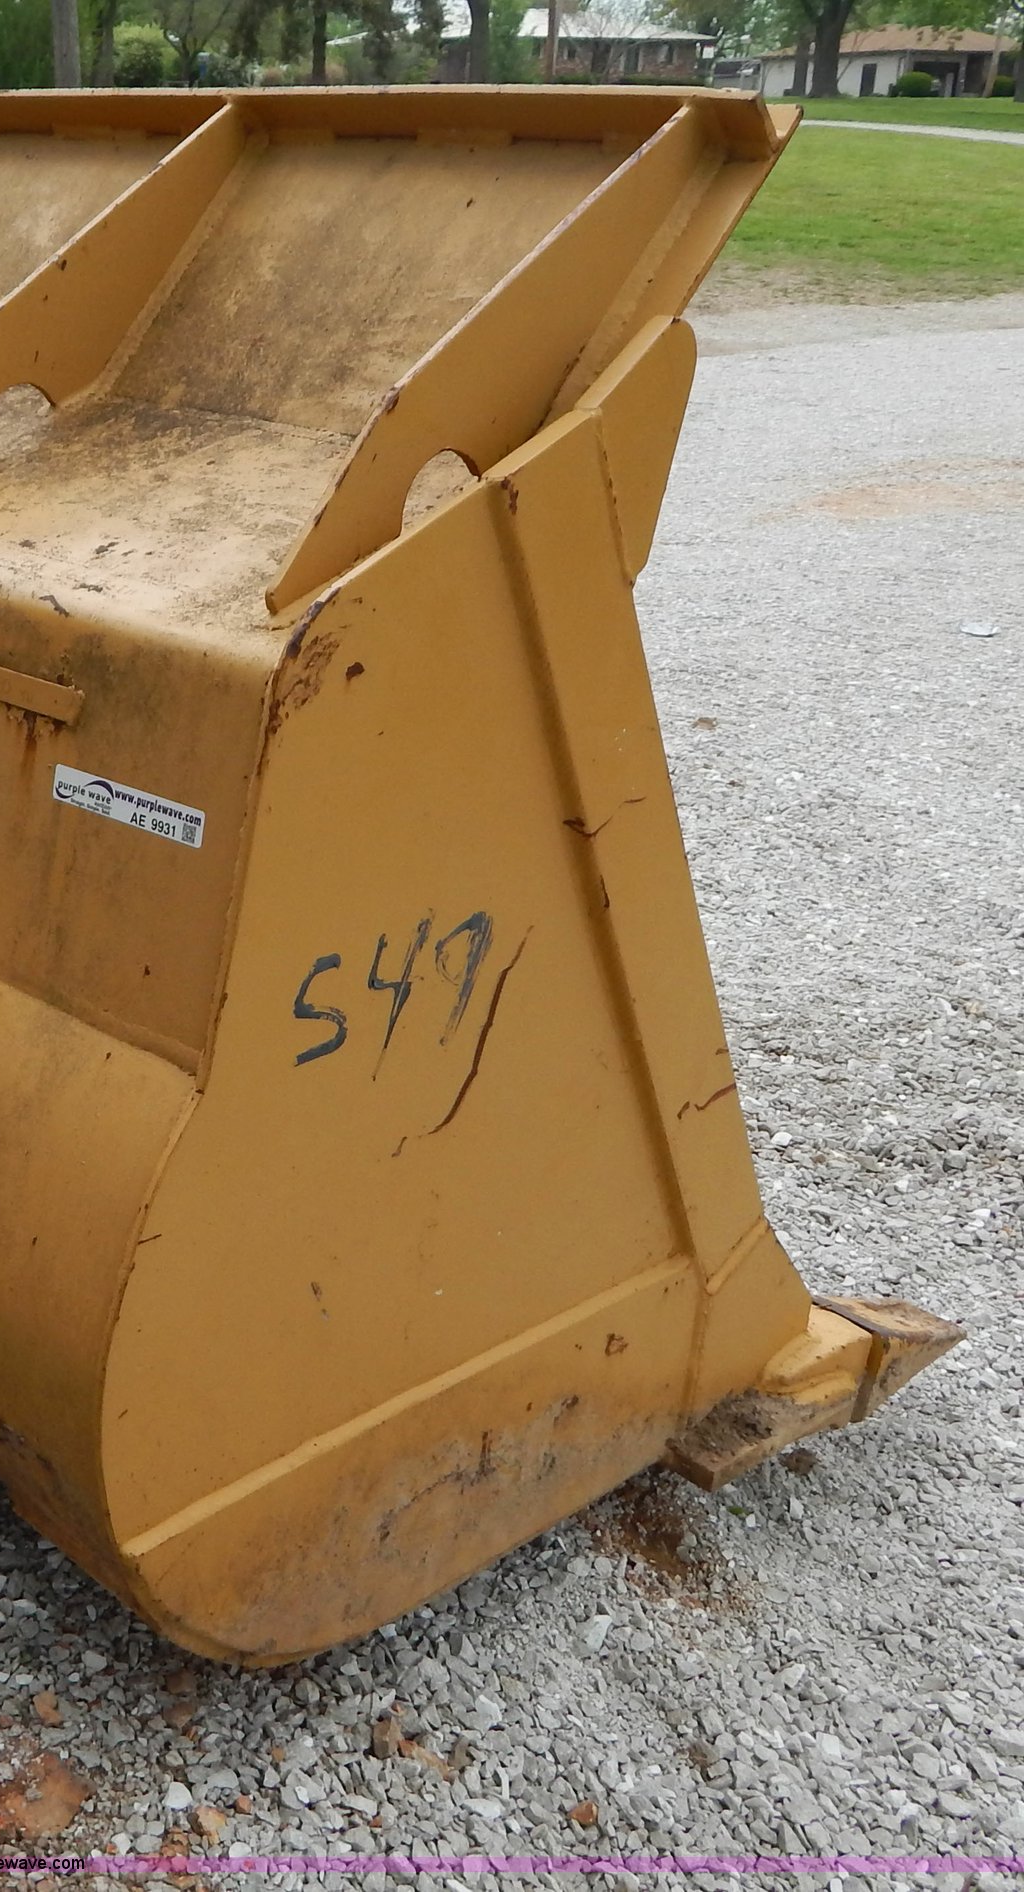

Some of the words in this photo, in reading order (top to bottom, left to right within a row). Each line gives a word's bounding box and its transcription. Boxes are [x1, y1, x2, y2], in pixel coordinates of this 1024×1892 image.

[57, 780, 86, 797] purple
[88, 790, 112, 805] wave
[114, 789, 202, 827] www.purplewave.com
[130, 812, 147, 828] AE
[151, 818, 176, 837] 9931
